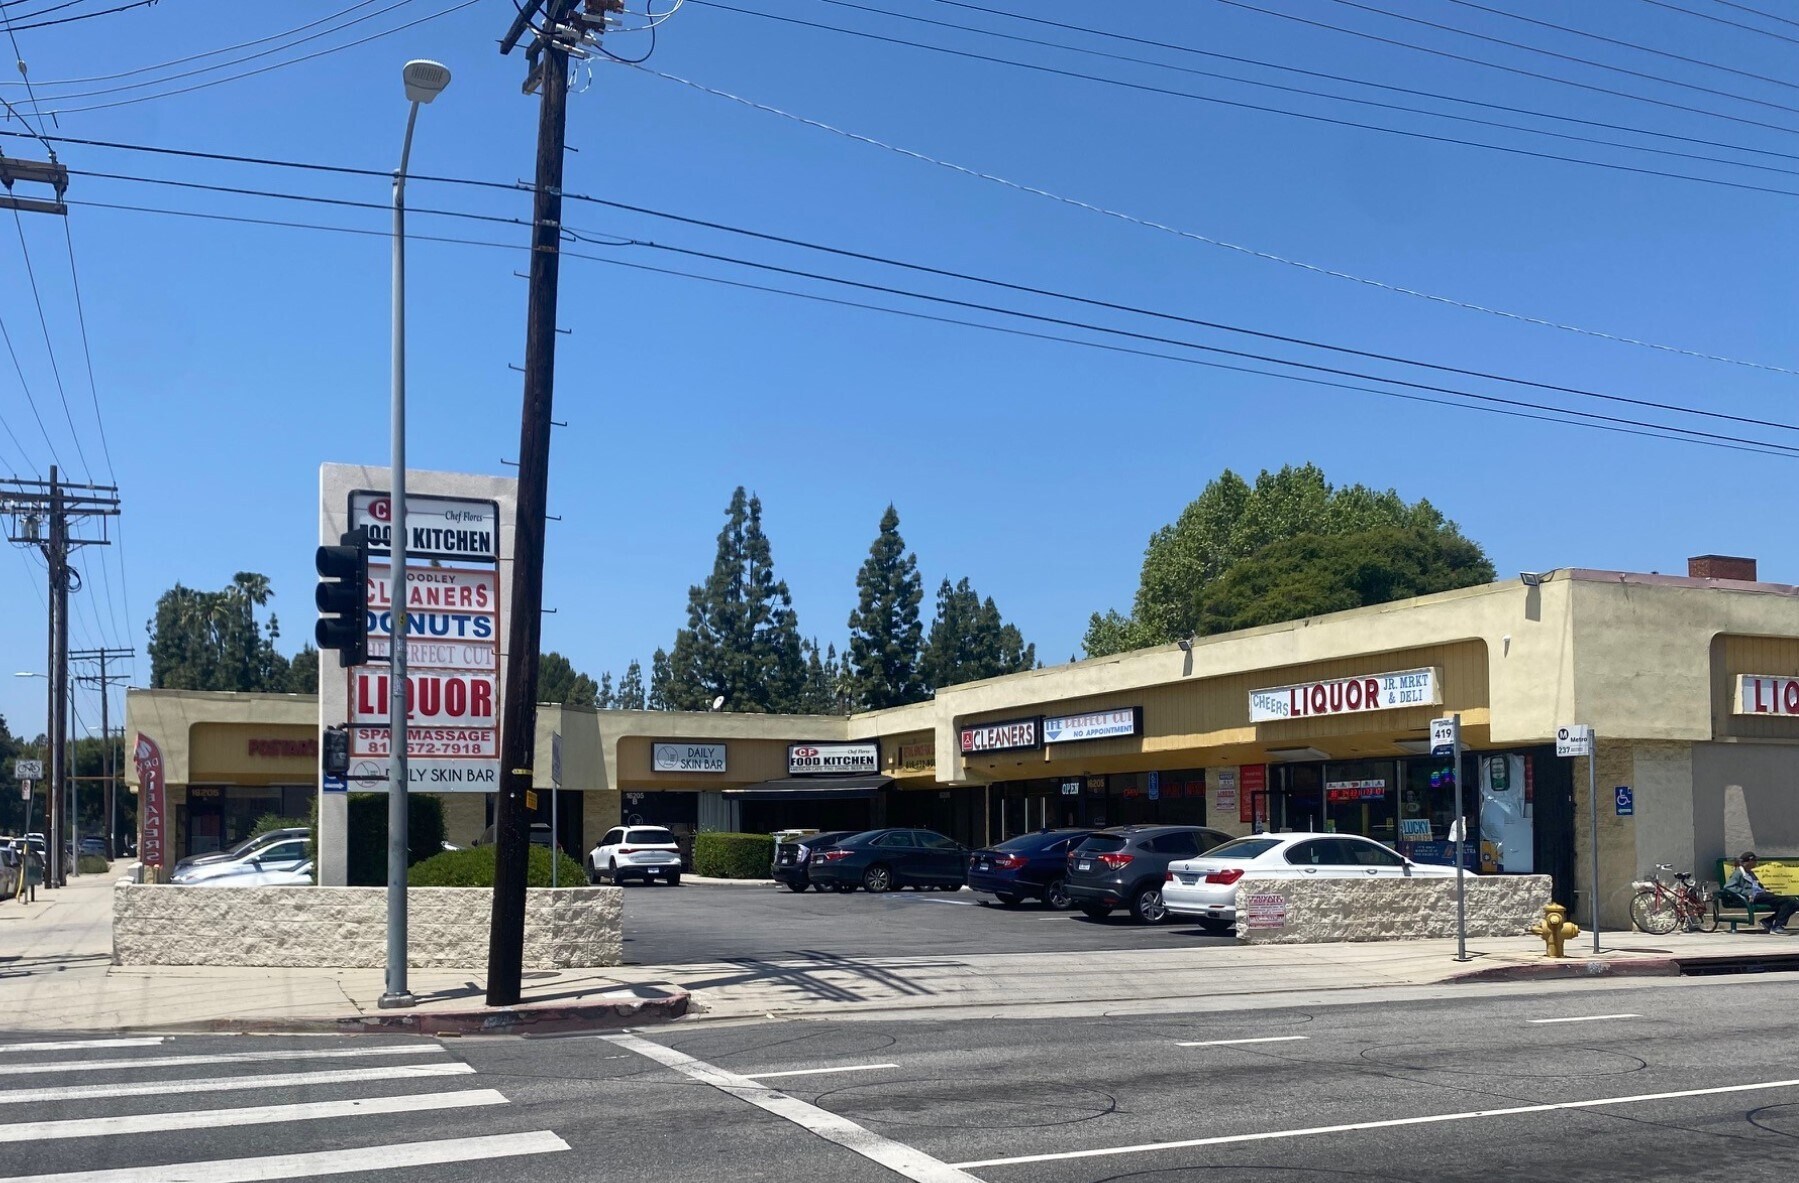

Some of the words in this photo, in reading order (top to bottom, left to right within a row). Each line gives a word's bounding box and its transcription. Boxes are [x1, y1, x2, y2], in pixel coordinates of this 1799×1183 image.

[445, 511, 462, 522] Chef
[463, 511, 483, 522] Flores
[413, 527, 490, 552] KITCHEN
[406, 573, 456, 584] OODLEY
[367, 578, 488, 607] CLANERS
[463, 645, 493, 664] CUT
[1383, 678, 1398, 690] JR.
[1400, 674, 1428, 688] MRKT
[1289, 678, 1380, 716] LIQUOR
[1389, 692, 1397, 704] &
[1400, 689, 1423, 703] DELI
[1253, 694, 1289, 717] CHEERS
[359, 730, 391, 740] SPA
[408, 730, 490, 742] MASSAGE
[973, 724, 1034, 749] CLEANERS
[1073, 729, 1084, 738] NO
[1086, 724, 1133, 737] APPOINTMENT
[1435, 729, 1452, 739] 419
[368, 742, 481, 754] 81572-7918
[687, 747, 715, 759] DAILY
[799, 748, 815, 756] CF
[680, 759, 701, 770] SKIN
[704, 759, 723, 770] BAR
[790, 757, 820, 766] FOOD
[823, 756, 874, 765] KITCHEN
[431, 769, 462, 782] SKIN
[467, 769, 494, 782] BAR
[1061, 782, 1080, 796] OPEN
[1403, 821, 1429, 835] LUCKY
